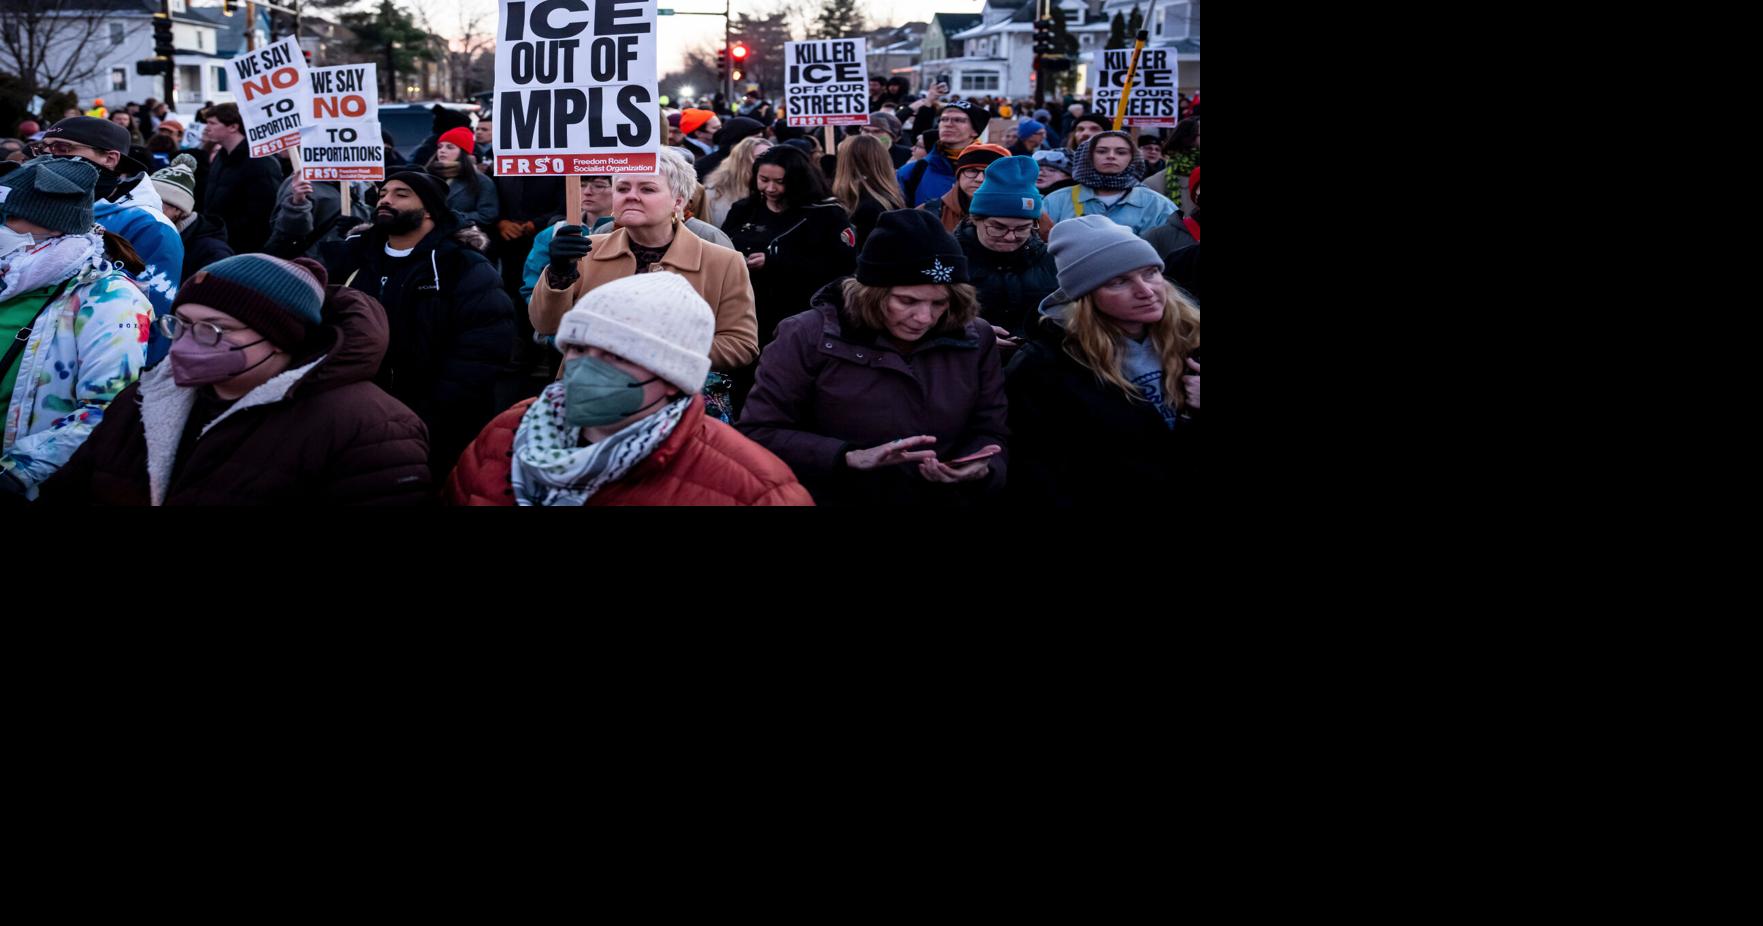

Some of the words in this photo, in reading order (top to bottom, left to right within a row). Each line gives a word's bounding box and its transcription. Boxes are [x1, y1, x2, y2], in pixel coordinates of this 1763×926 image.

[505, 0, 651, 41] ICE
[235, 55, 260, 79] WE
[261, 42, 293, 70] SAY
[511, 39, 579, 85] OUT
[591, 35, 638, 82] OF
[795, 41, 855, 64] KILLER
[242, 66, 299, 101] NO
[310, 71, 333, 94] WE
[336, 68, 365, 92] SAY
[790, 62, 864, 84] ICE
[1099, 69, 1173, 87] ICE
[789, 85, 823, 95] OFF
[827, 84, 864, 93] OUR
[1097, 89, 1121, 97] OF
[1135, 89, 1173, 97] OUR
[261, 98, 295, 118] TO
[313, 95, 367, 119] NO
[789, 93, 865, 115] STREETS
[248, 112, 302, 142] DEPORTATI
[500, 84, 652, 150] MPLS
[326, 128, 358, 143] TO
[303, 146, 382, 162] DEPORTATIONS
[502, 156, 565, 174] FRSO
[608, 157, 628, 165] Road
[304, 168, 338, 179] FRSO
[606, 164, 653, 174] Organization
